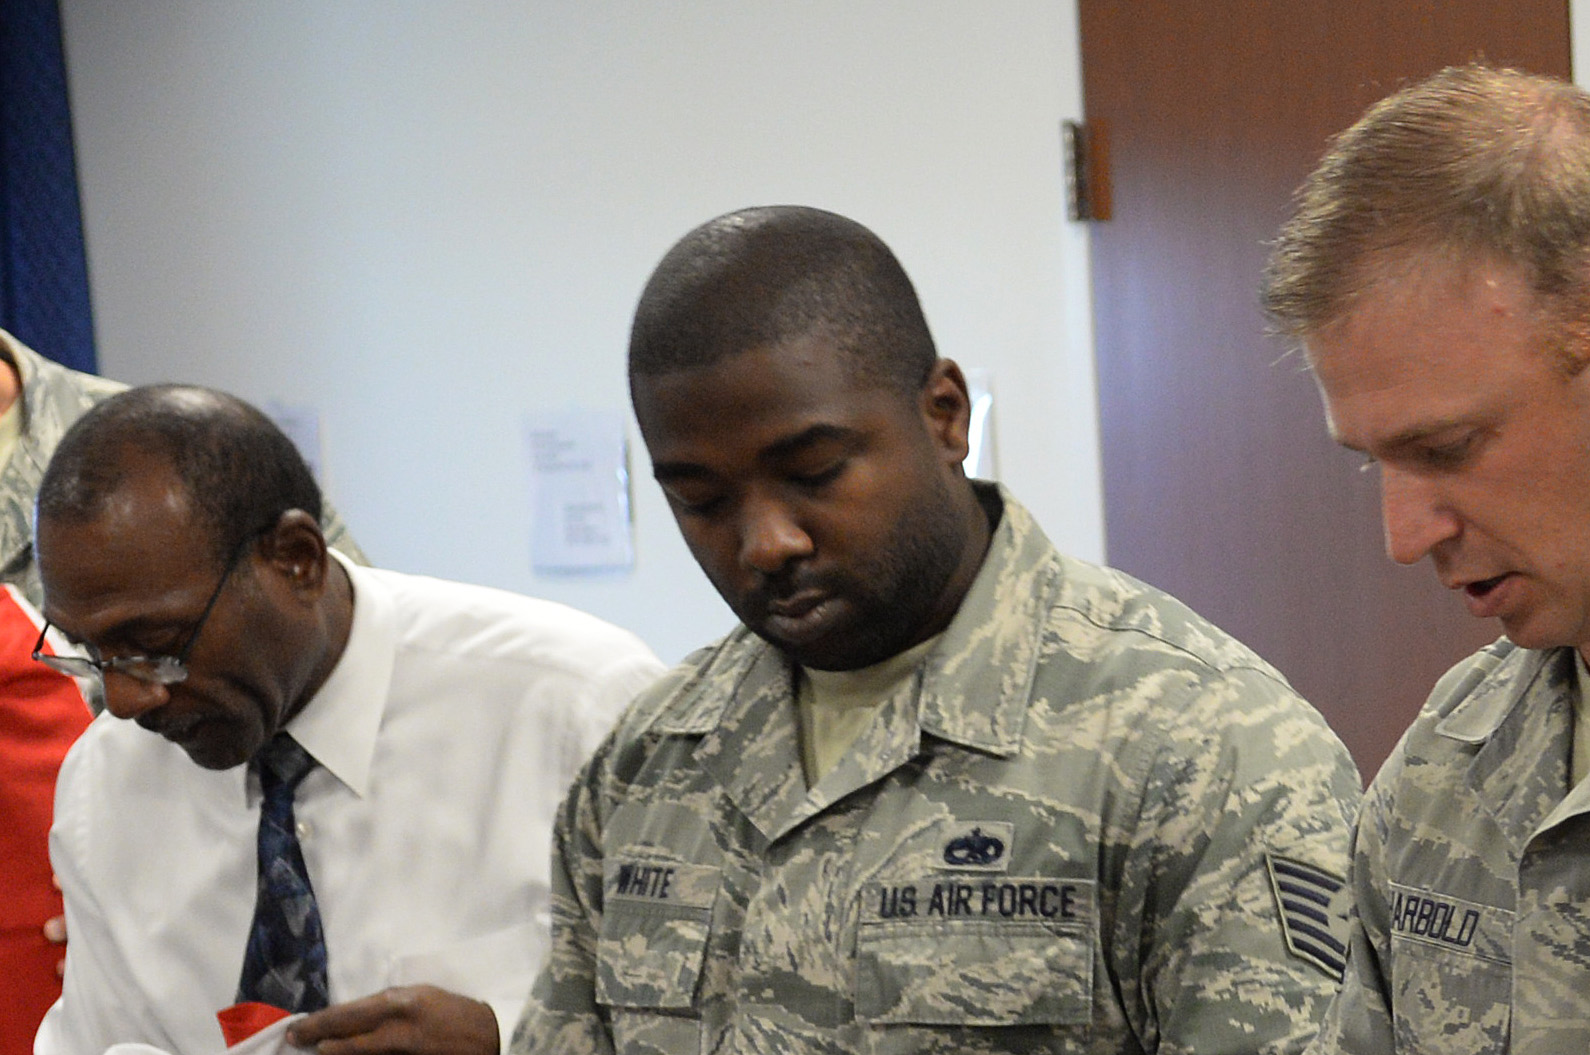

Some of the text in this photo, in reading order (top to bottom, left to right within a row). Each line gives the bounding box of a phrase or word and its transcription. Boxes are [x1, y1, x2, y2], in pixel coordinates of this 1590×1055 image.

[617, 864, 675, 899] WHITE
[928, 884, 973, 916] AIR
[981, 884, 1077, 918] FORCE
[1389, 891, 1480, 947] ARBOLD
